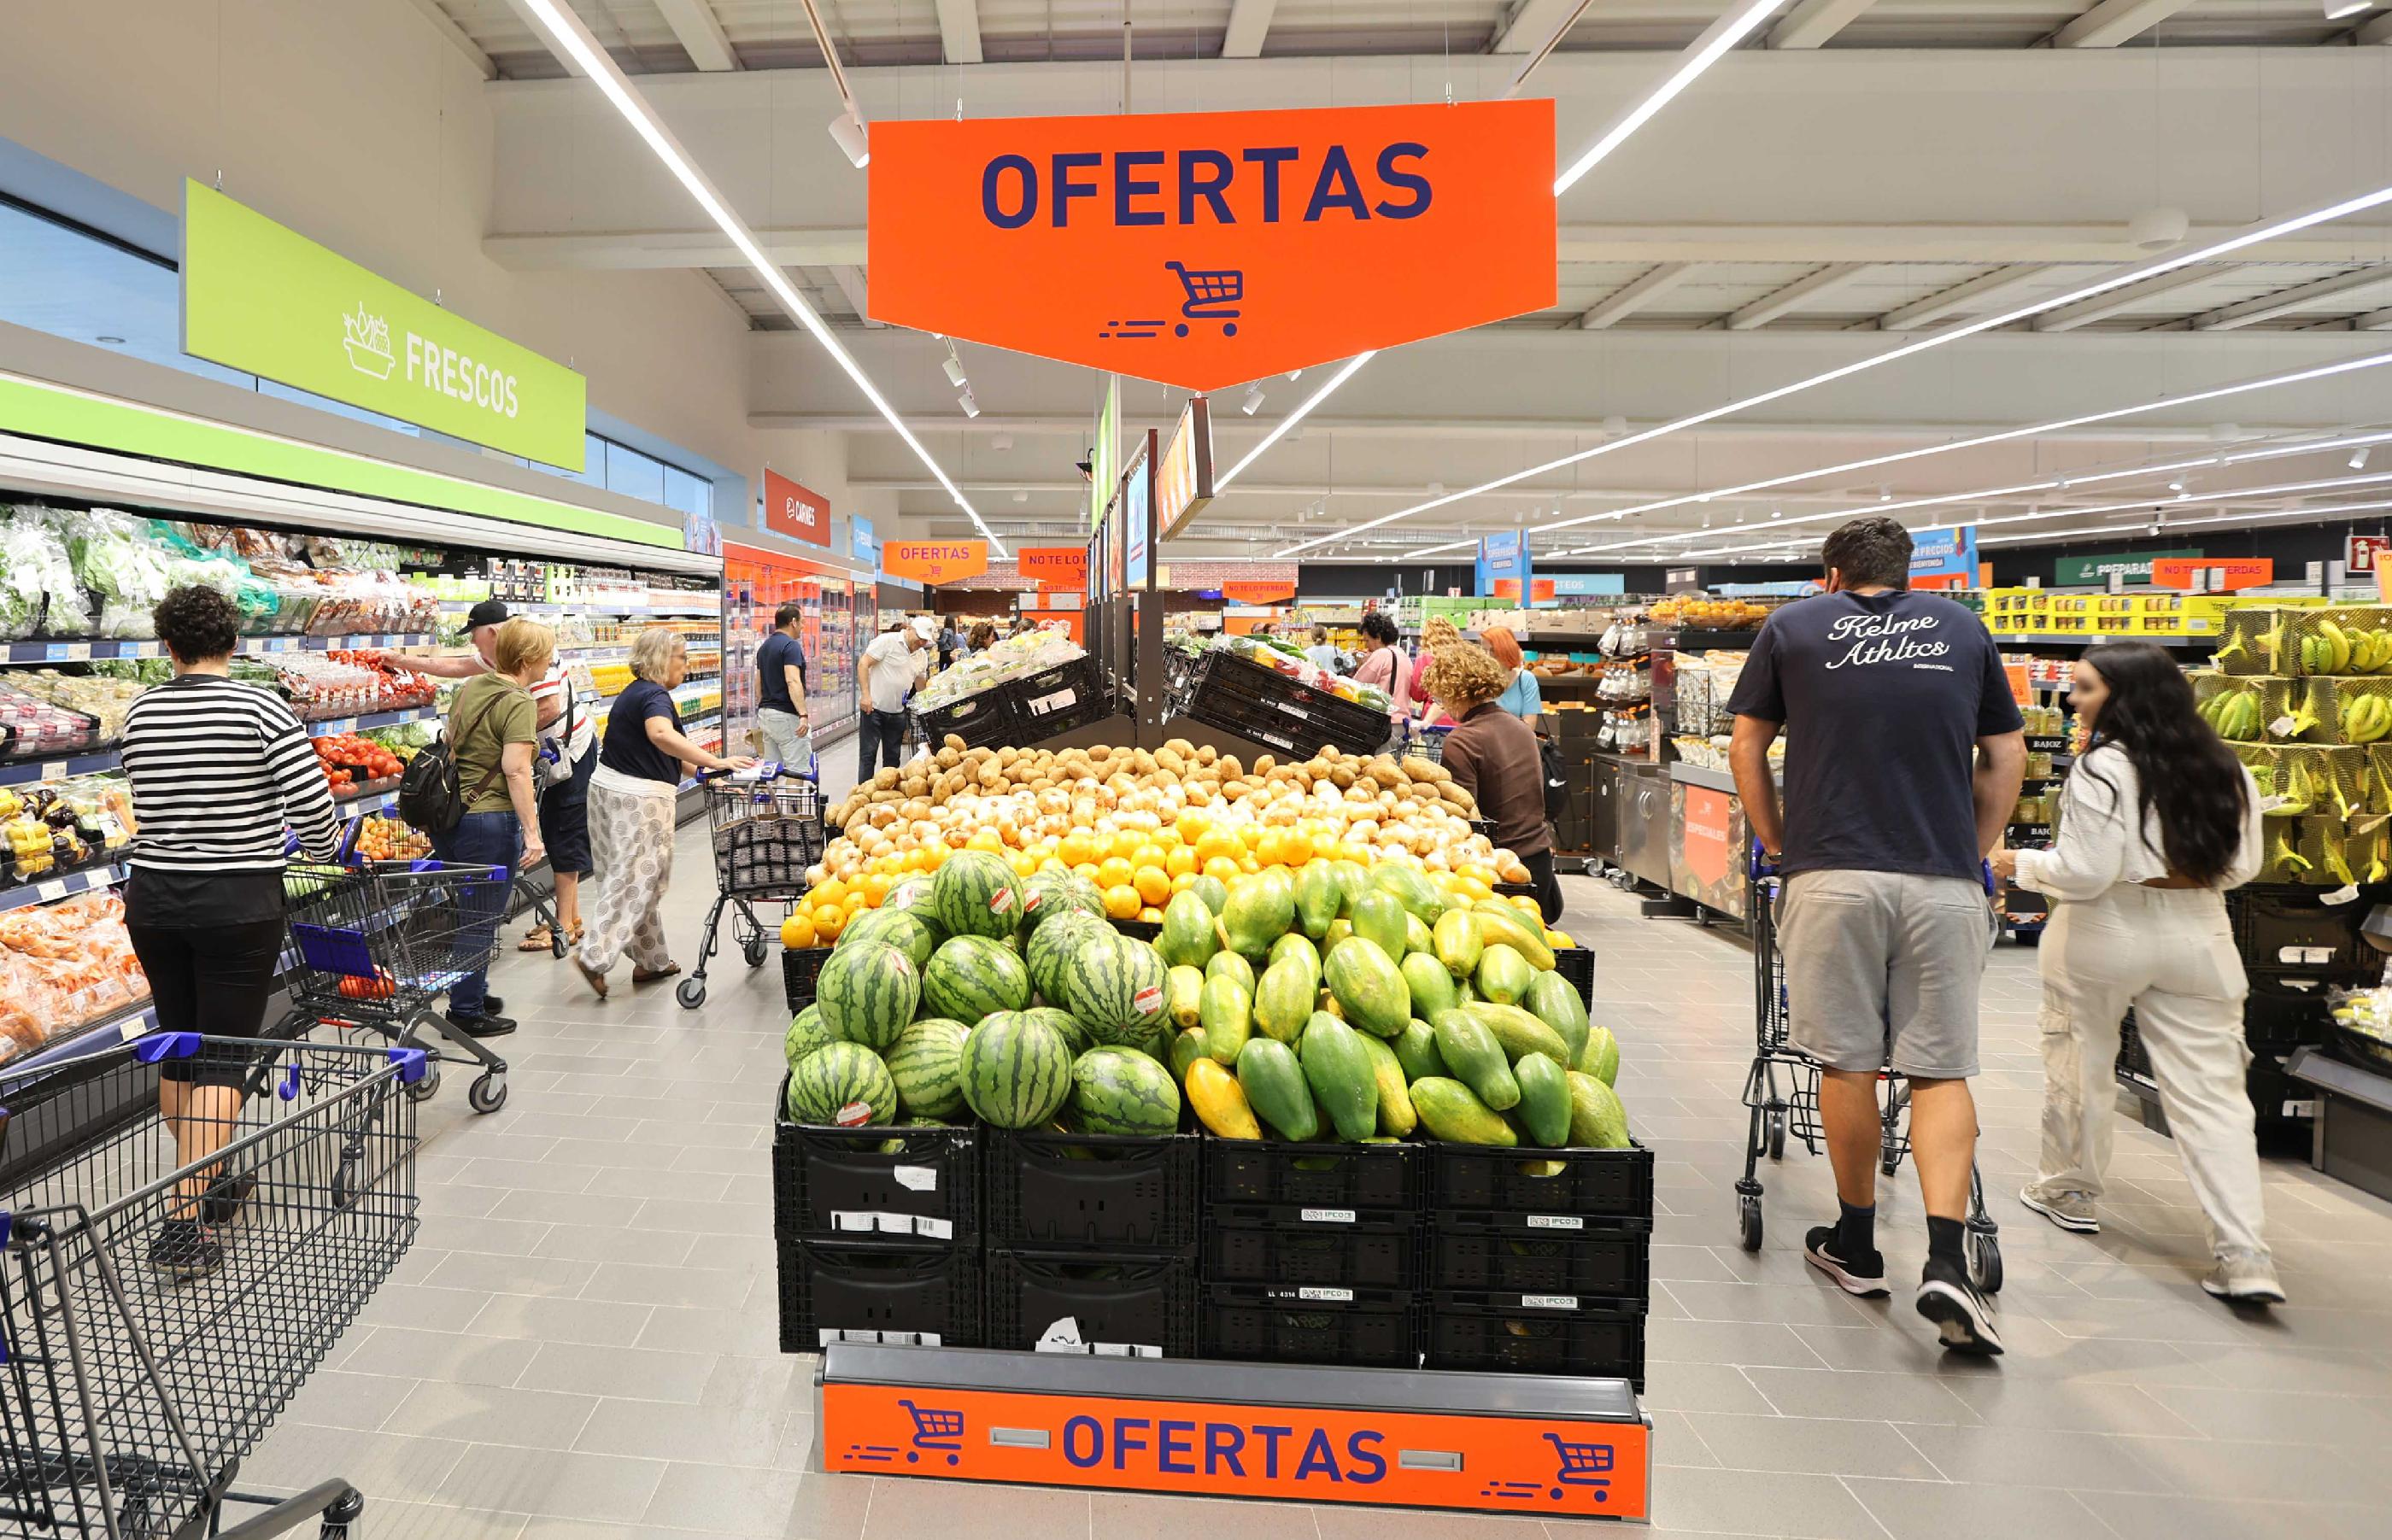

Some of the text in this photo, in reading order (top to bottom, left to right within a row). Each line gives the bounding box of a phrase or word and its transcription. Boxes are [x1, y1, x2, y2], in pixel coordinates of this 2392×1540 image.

[982, 142, 1433, 229] OFERTAS
[406, 331, 519, 418] FRESCOS
[795, 500, 815, 527] CARNES
[900, 547, 970, 560] OFERTAS
[1029, 555, 1045, 565] NO
[1047, 555, 1062, 565] TE
[1065, 555, 1080, 565] LO
[2096, 561, 2154, 577] PREPARAD
[2165, 565, 2180, 575] NO
[1827, 614, 1939, 641] Kelme
[1825, 635, 1950, 669] Athltcs
[2032, 740, 2062, 749] BAJOZ
[1686, 822, 1727, 842] ESPECIALES
[2030, 828, 2051, 836] BAJO
[1063, 1414, 1387, 1484] OFERTAS
